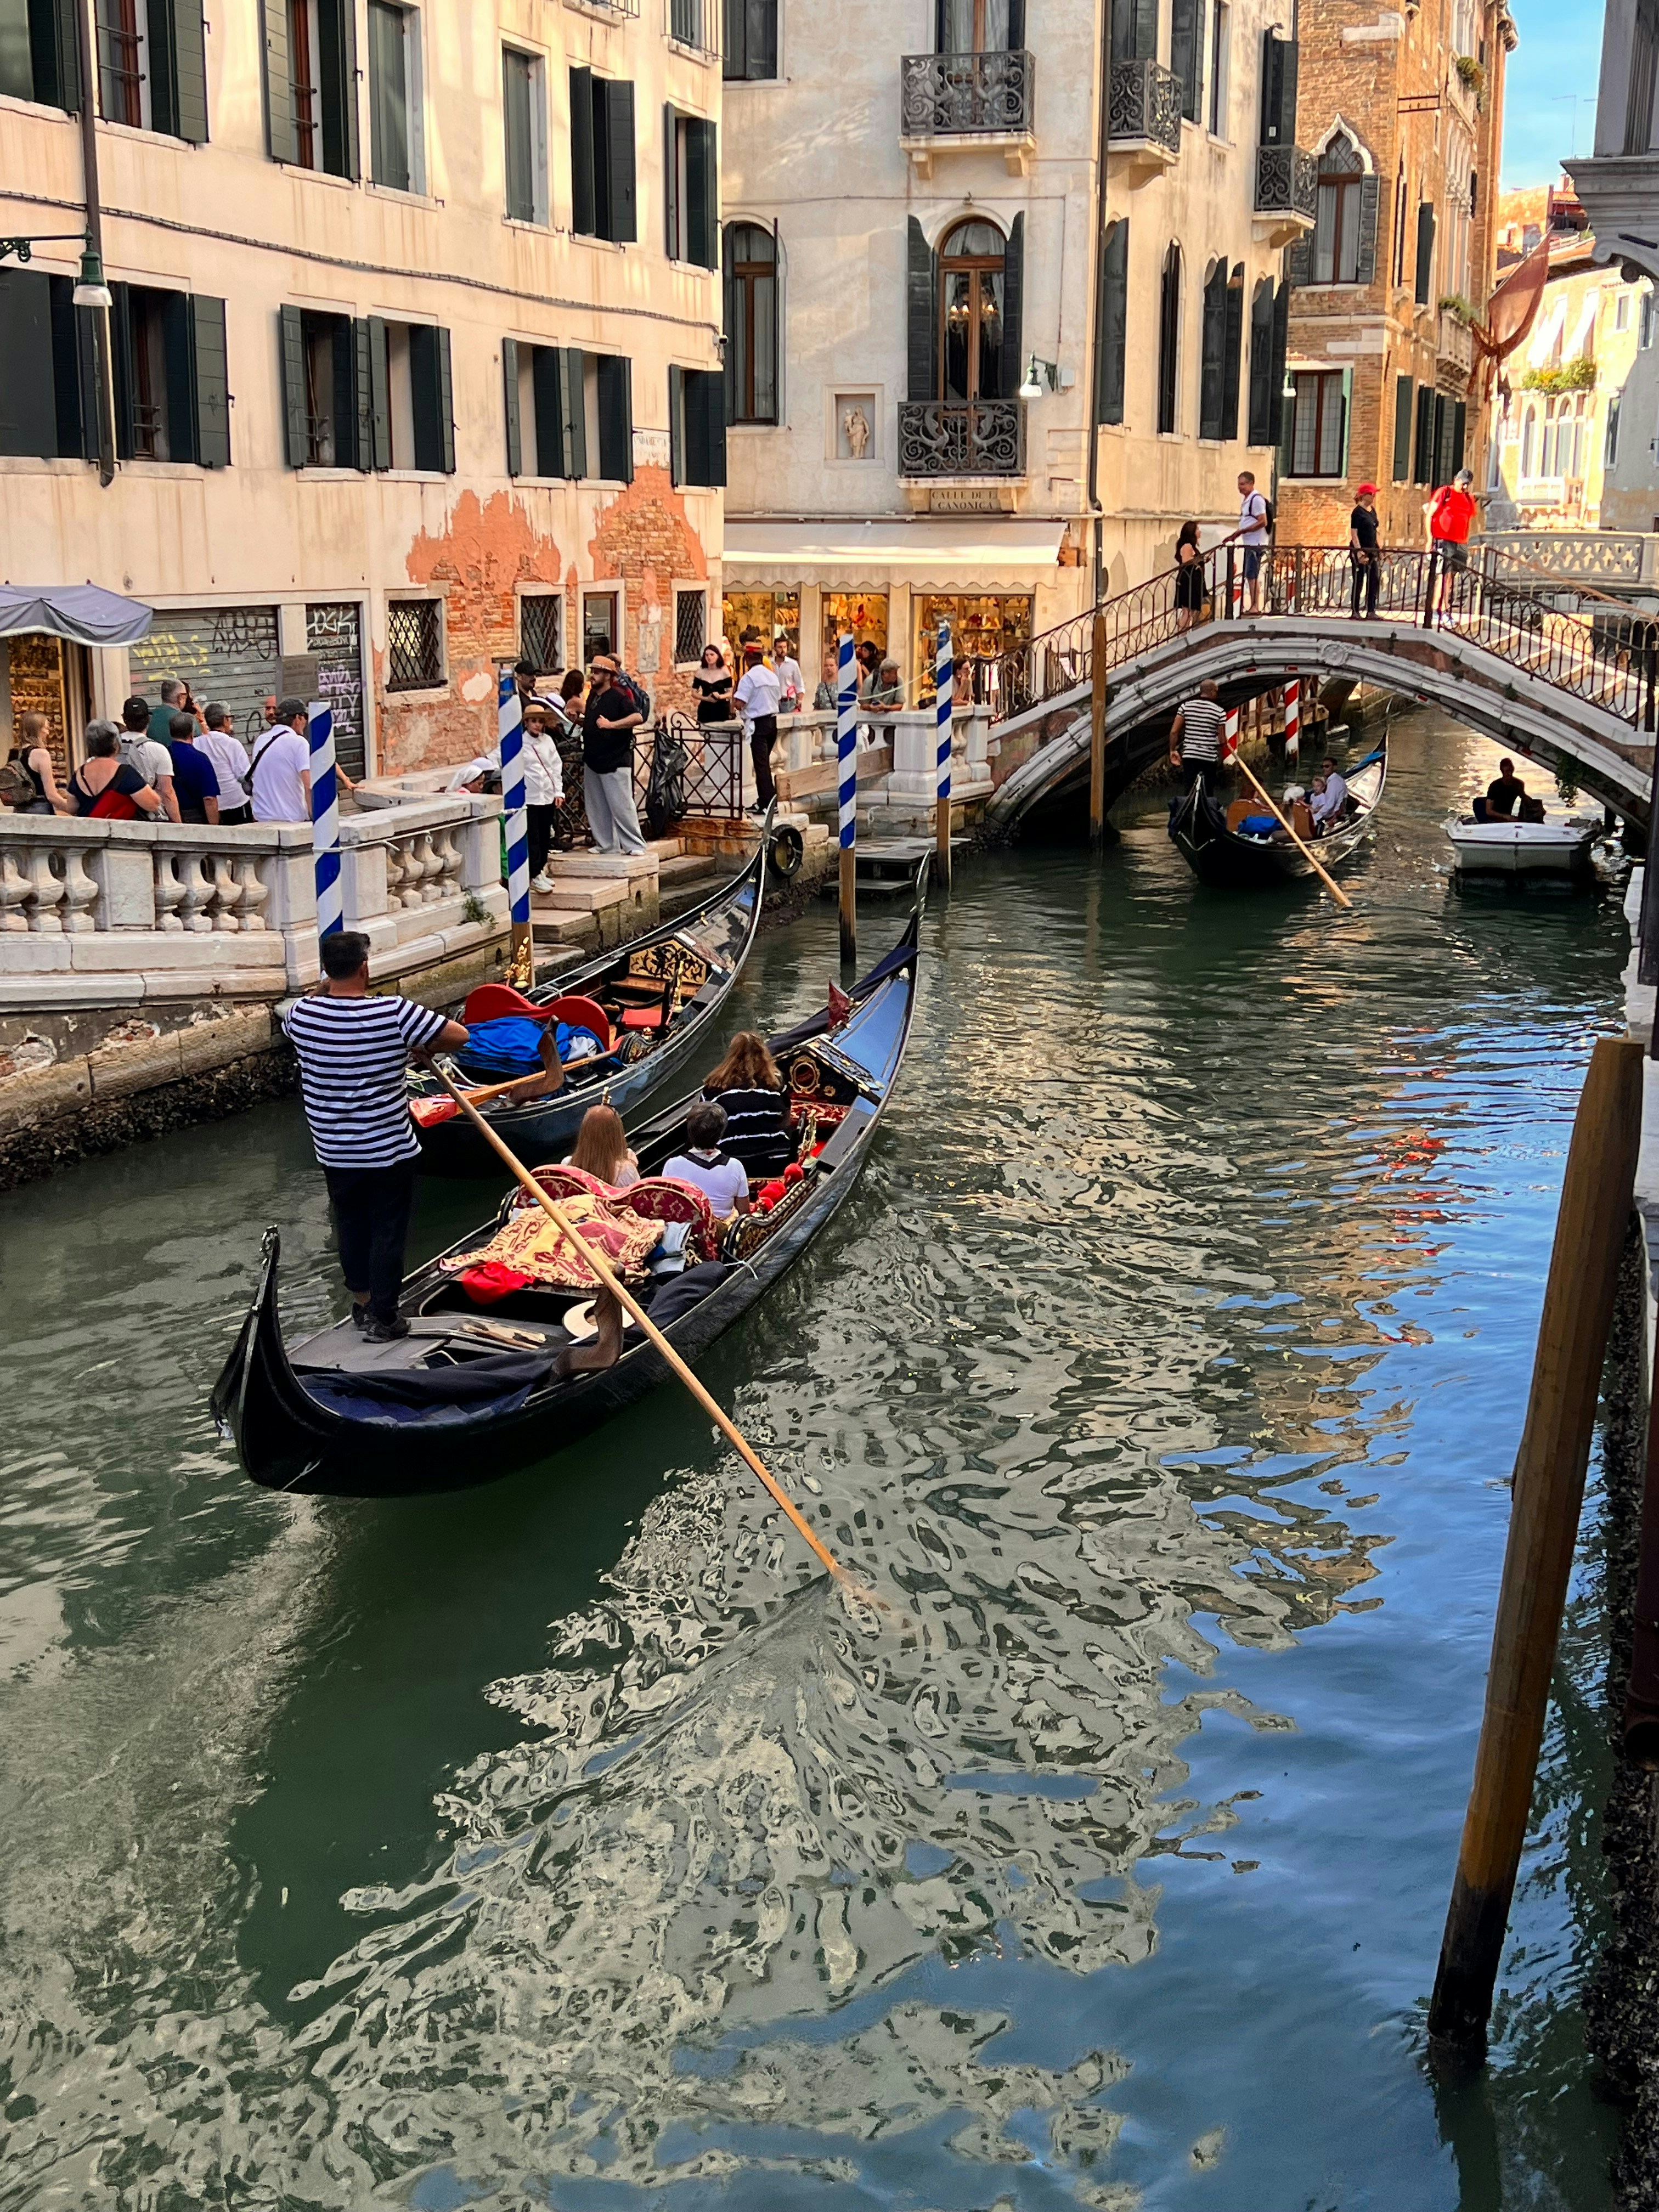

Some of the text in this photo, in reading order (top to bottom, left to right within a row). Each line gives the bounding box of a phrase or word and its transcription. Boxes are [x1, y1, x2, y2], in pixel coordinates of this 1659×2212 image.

[932, 491, 966, 499] CALLE
[971, 491, 983, 499] DE
[938, 501, 993, 510] CANONICA
